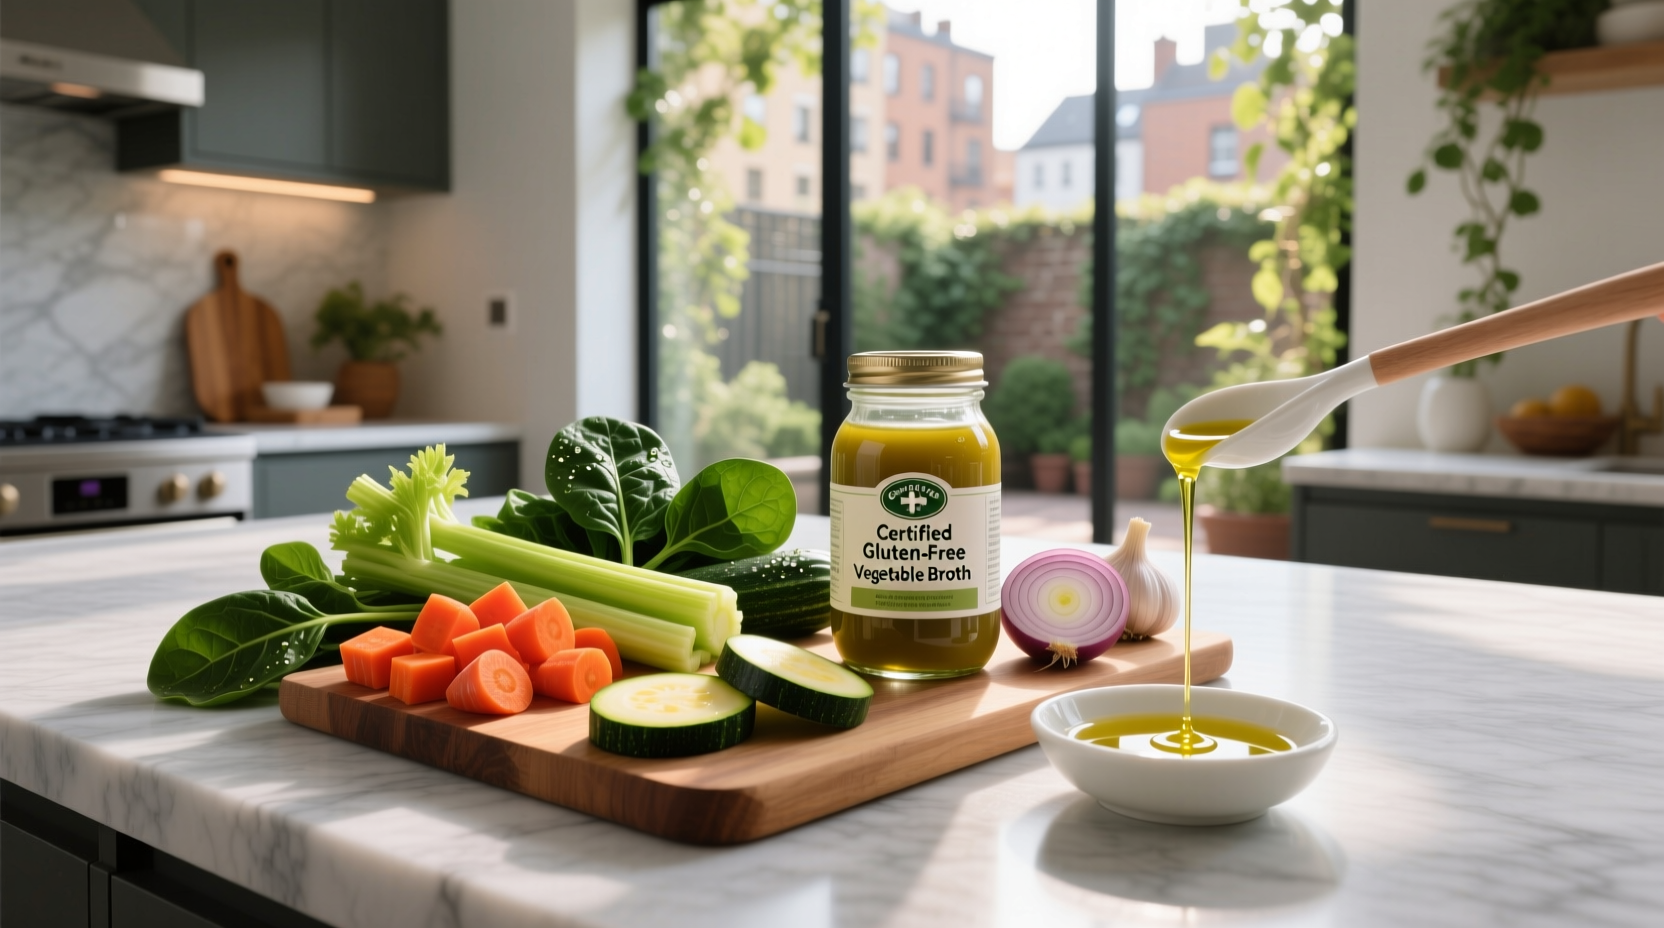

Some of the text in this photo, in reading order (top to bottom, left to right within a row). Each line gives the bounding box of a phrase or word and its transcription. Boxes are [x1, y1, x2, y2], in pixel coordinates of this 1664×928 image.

[876, 523, 952, 542] Certified
[862, 542, 966, 560] Gluten-Free
[853, 563, 971, 584] Vegetable Broth
